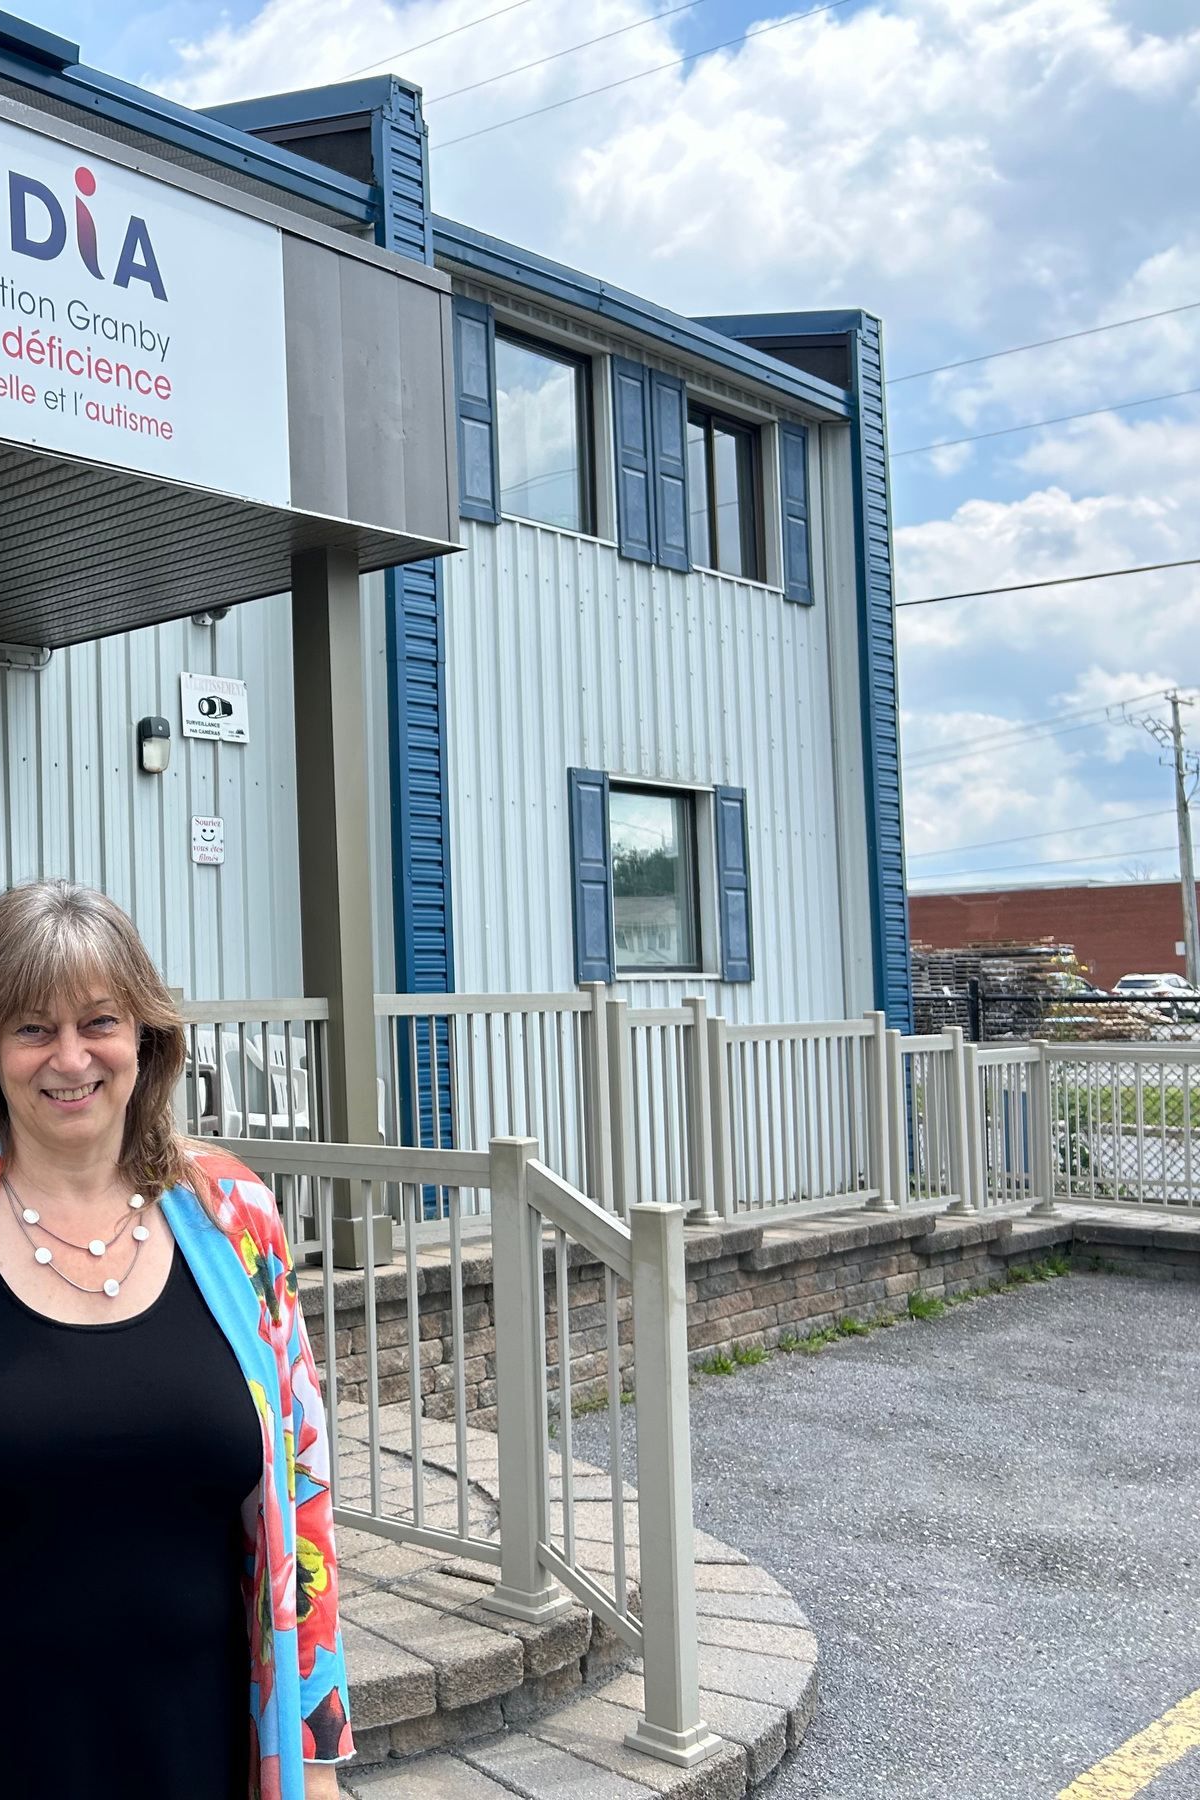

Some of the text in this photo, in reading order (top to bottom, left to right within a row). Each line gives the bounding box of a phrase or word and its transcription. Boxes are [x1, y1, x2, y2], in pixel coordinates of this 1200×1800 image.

[67, 299, 170, 362] Granby
[2, 325, 172, 400] déficience
[44, 387, 67, 412] et
[74, 393, 174, 440] l'autisme
[186, 719, 220, 728] SURVEILLANCE
[194, 818, 221, 827] Souriez
